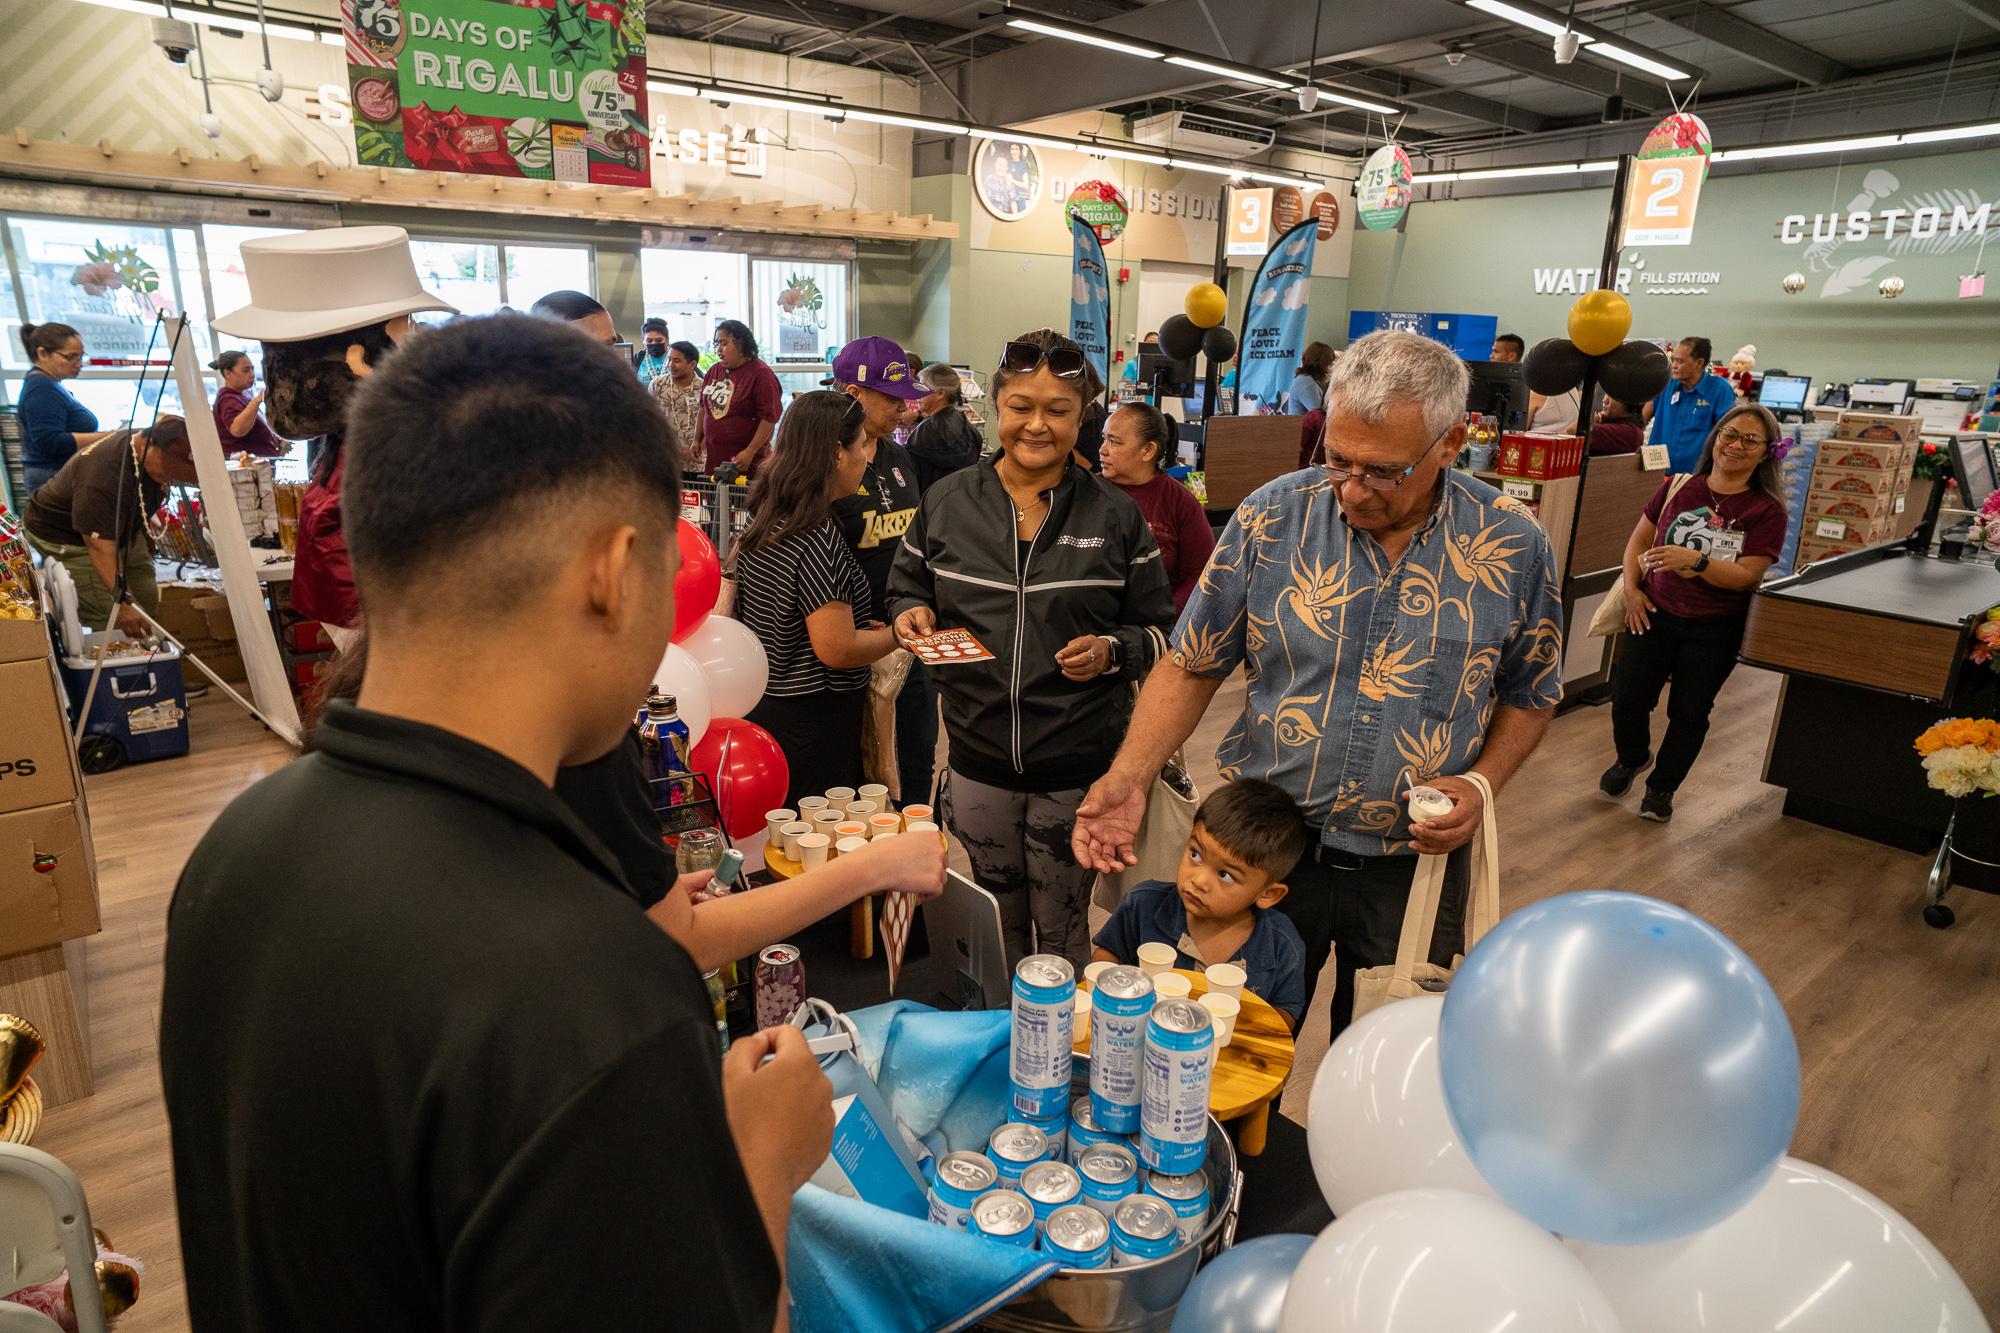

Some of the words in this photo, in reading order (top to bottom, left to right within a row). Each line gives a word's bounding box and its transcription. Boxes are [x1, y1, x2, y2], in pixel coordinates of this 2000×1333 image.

[410, 12, 488, 46] DAYS
[495, 26, 534, 51] OF
[413, 50, 575, 103] RIGALU
[623, 72, 636, 84] 75
[587, 110, 621, 120] ANNIVERSARY
[605, 119, 623, 127] BUNDLE
[1368, 169, 1384, 188] 75
[1645, 167, 1684, 218] 2
[1081, 204, 1101, 212] DAYS
[1103, 204, 1114, 212] OF
[1082, 212, 1123, 222] RIGALU
[1239, 196, 1262, 234] 3
[1781, 203, 1992, 244] CUSTOM
[1533, 267, 1633, 295] WATR
[1640, 272, 1666, 284] FILL
[1668, 272, 1721, 284] STATION
[1251, 327, 1281, 338] PEACE
[793, 341, 811, 351] Exit
[1250, 339, 1272, 349] LOVE
[1250, 350, 1266, 360] ICE
[1267, 349, 1295, 360] CREAM
[0, 758, 37, 780] PS
[1106, 1040, 1135, 1048] WATER
